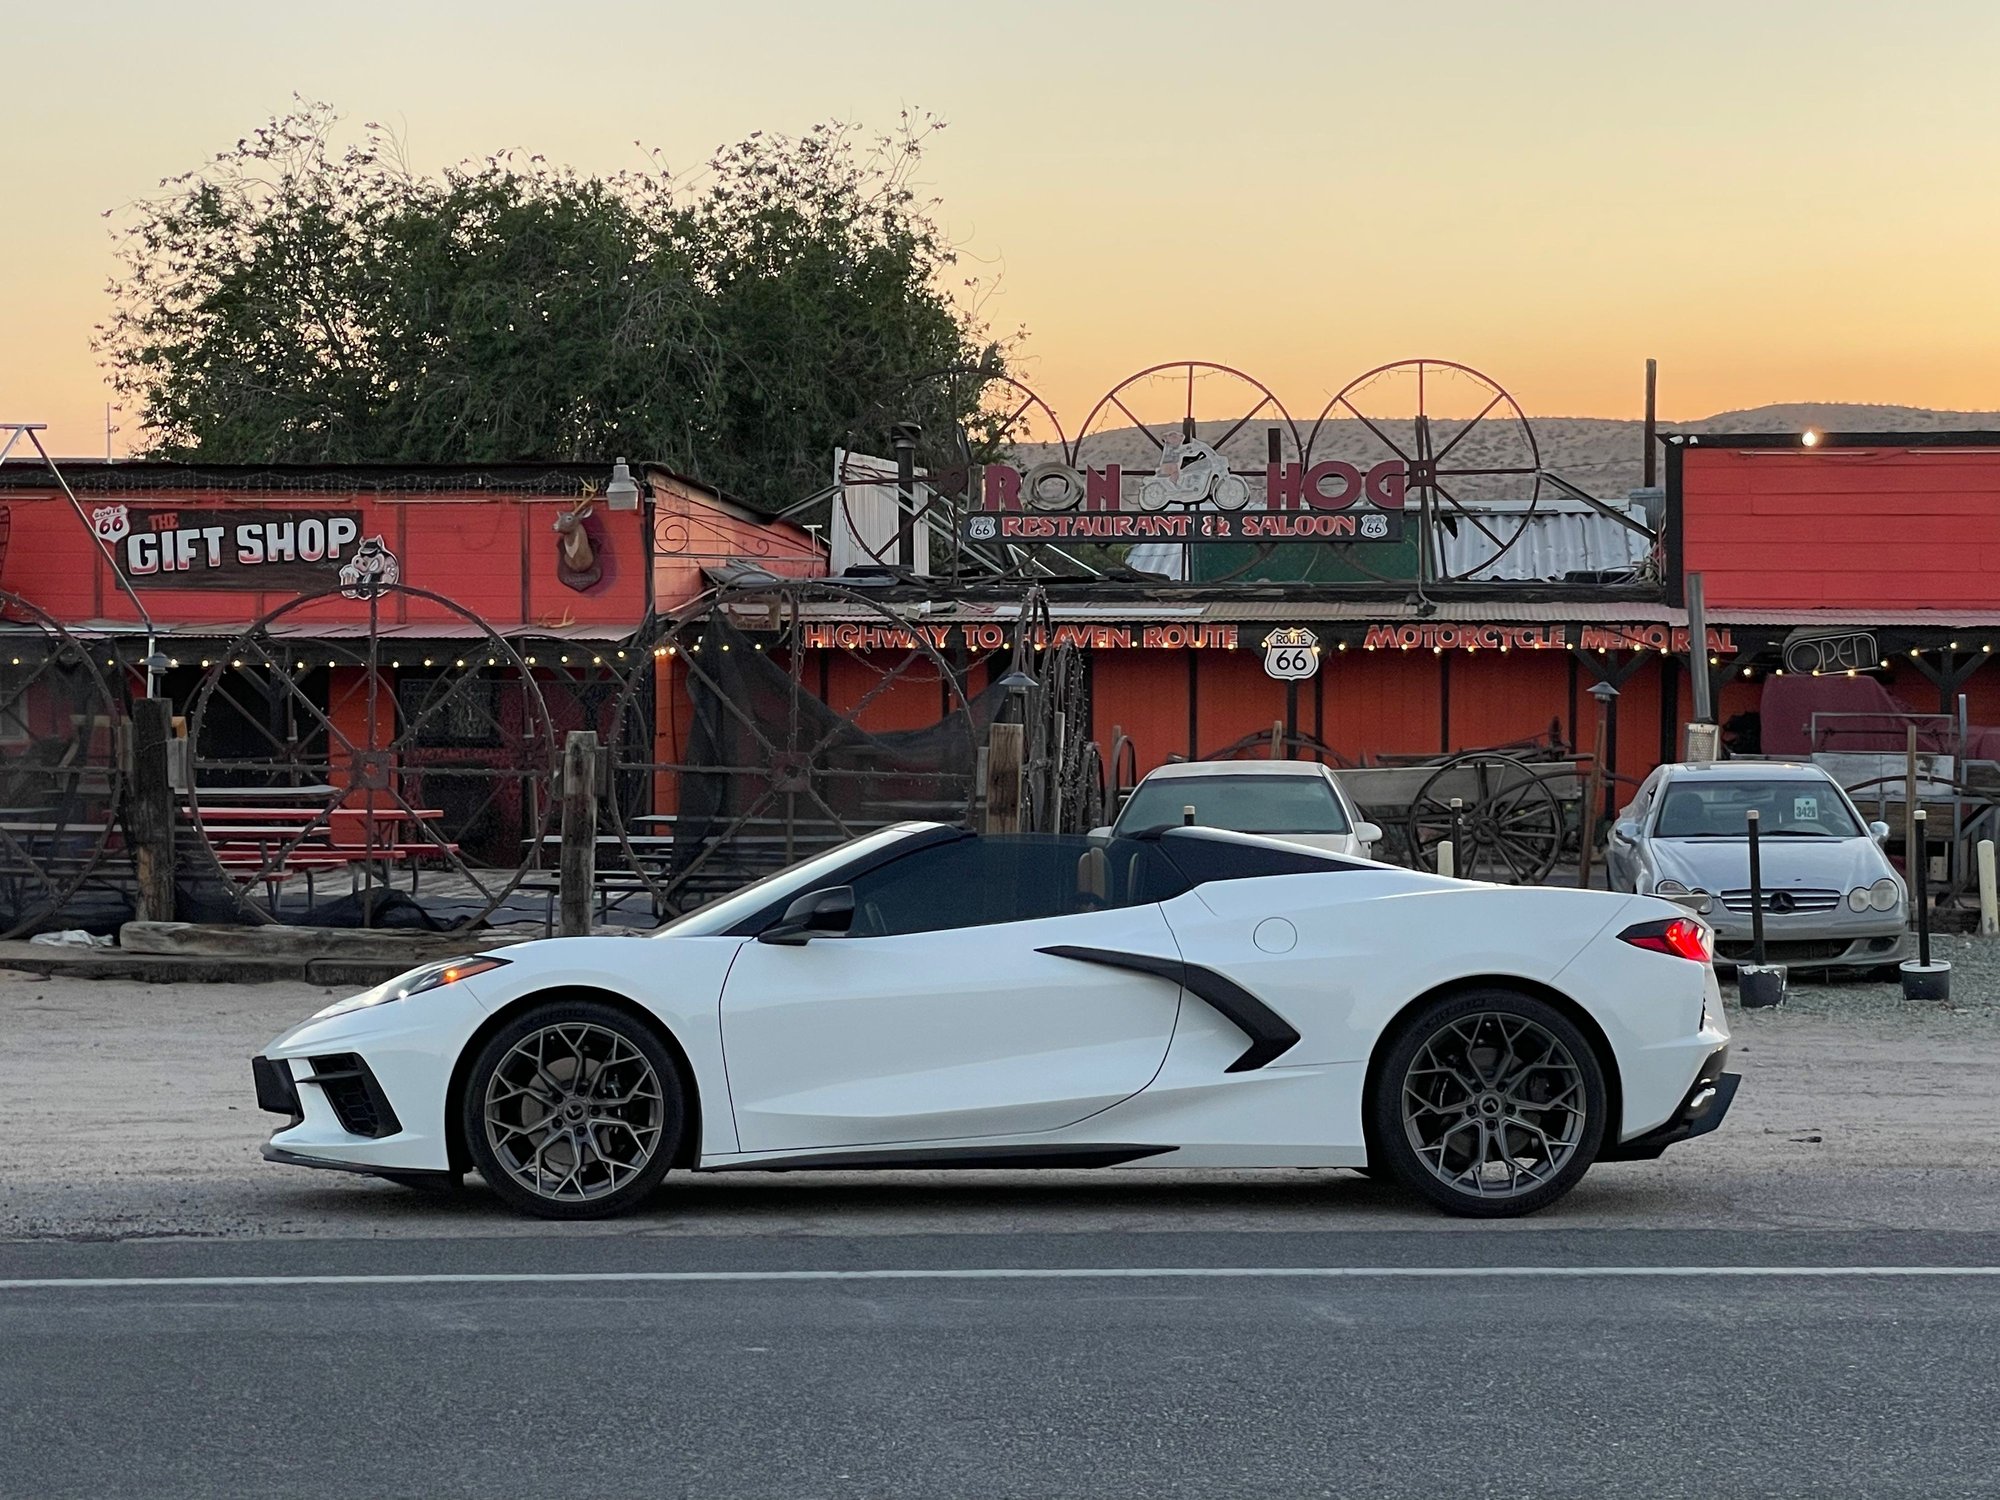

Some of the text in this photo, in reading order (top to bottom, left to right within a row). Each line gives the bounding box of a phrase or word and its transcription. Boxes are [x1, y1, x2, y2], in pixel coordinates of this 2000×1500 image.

[1267, 459, 1405, 510] HOG
[99, 516, 123, 535] 66
[148, 512, 179, 531] THE
[975, 525, 990, 535] 66
[1001, 515, 1356, 537] RESTAURANT & SALOON
[1366, 523, 1382, 533] 66
[127, 517, 357, 576] GIFT SHOP
[962, 624, 1004, 649] TO
[1143, 624, 1239, 649] ROUTE
[1276, 634, 1307, 645] ROUTE
[1363, 623, 1738, 652] MOTORCYCLE MEMORAL
[1276, 649, 1307, 671] 66
